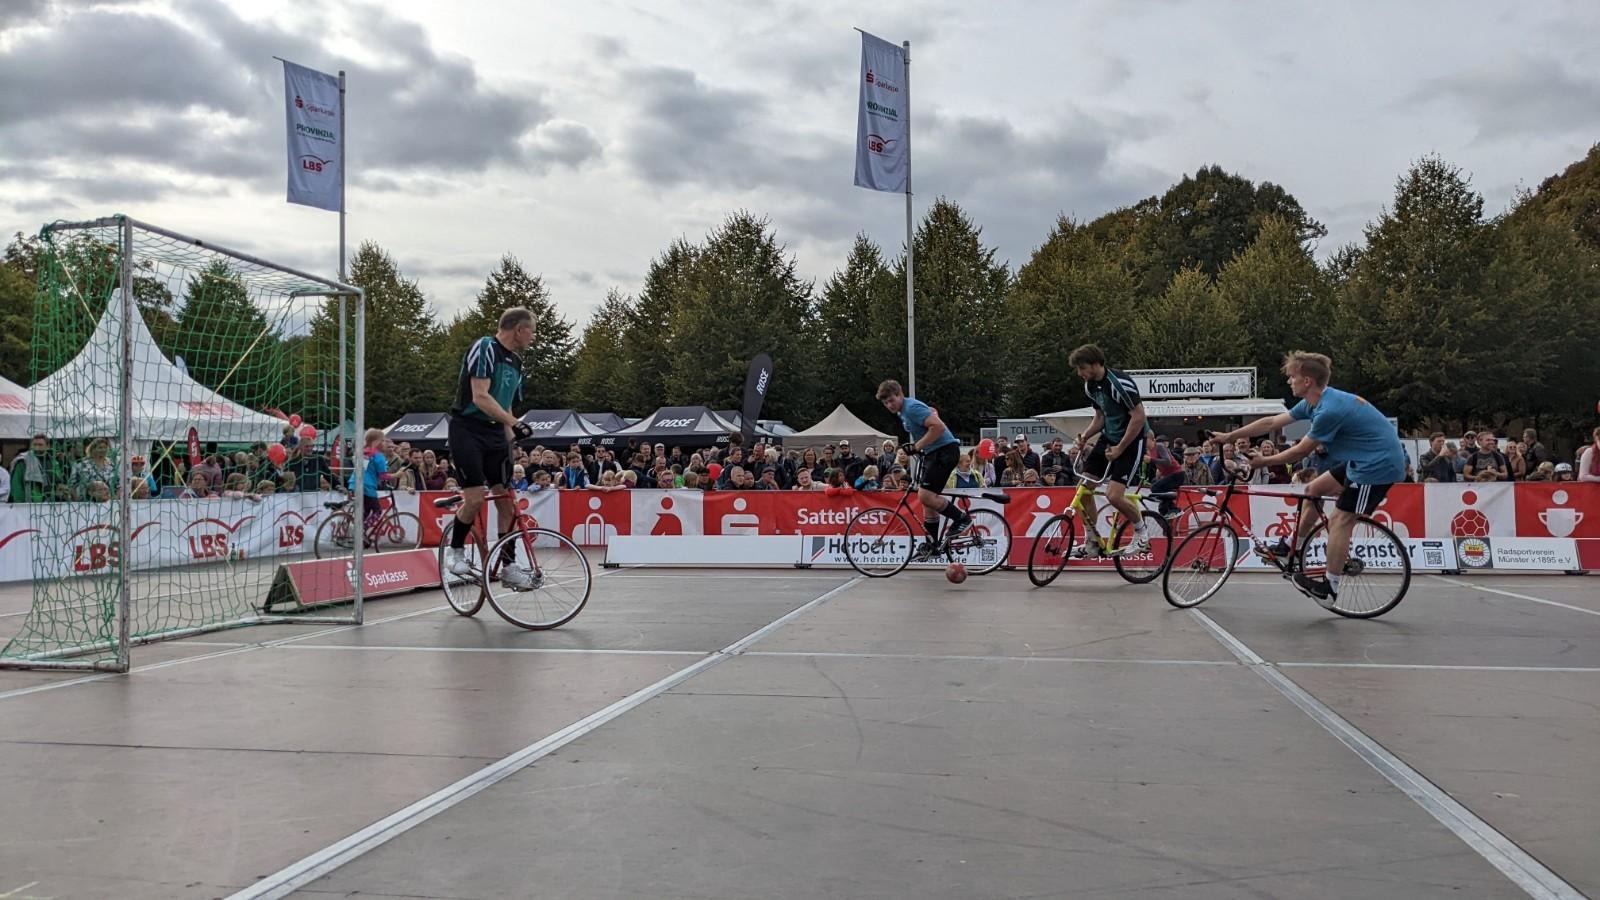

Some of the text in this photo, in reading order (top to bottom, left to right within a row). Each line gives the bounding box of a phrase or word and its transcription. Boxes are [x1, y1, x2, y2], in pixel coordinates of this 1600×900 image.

[868, 139, 883, 153] LBS
[303, 160, 322, 172] LBS
[756, 368, 769, 395] ROSE
[1149, 379, 1215, 393] Krombacher
[395, 423, 433, 433] ROSE
[655, 418, 695, 428] ROSE
[577, 437, 593, 445] ROSE
[600, 437, 616, 445] ROSE
[797, 507, 888, 525] Sattelfest
[280, 525, 304, 547] LBS
[189, 533, 228, 559] LBS
[1497, 547, 1555, 556] Radsportverein
[74, 541, 121, 572] LBS
[365, 569, 409, 588] Sparkasse
